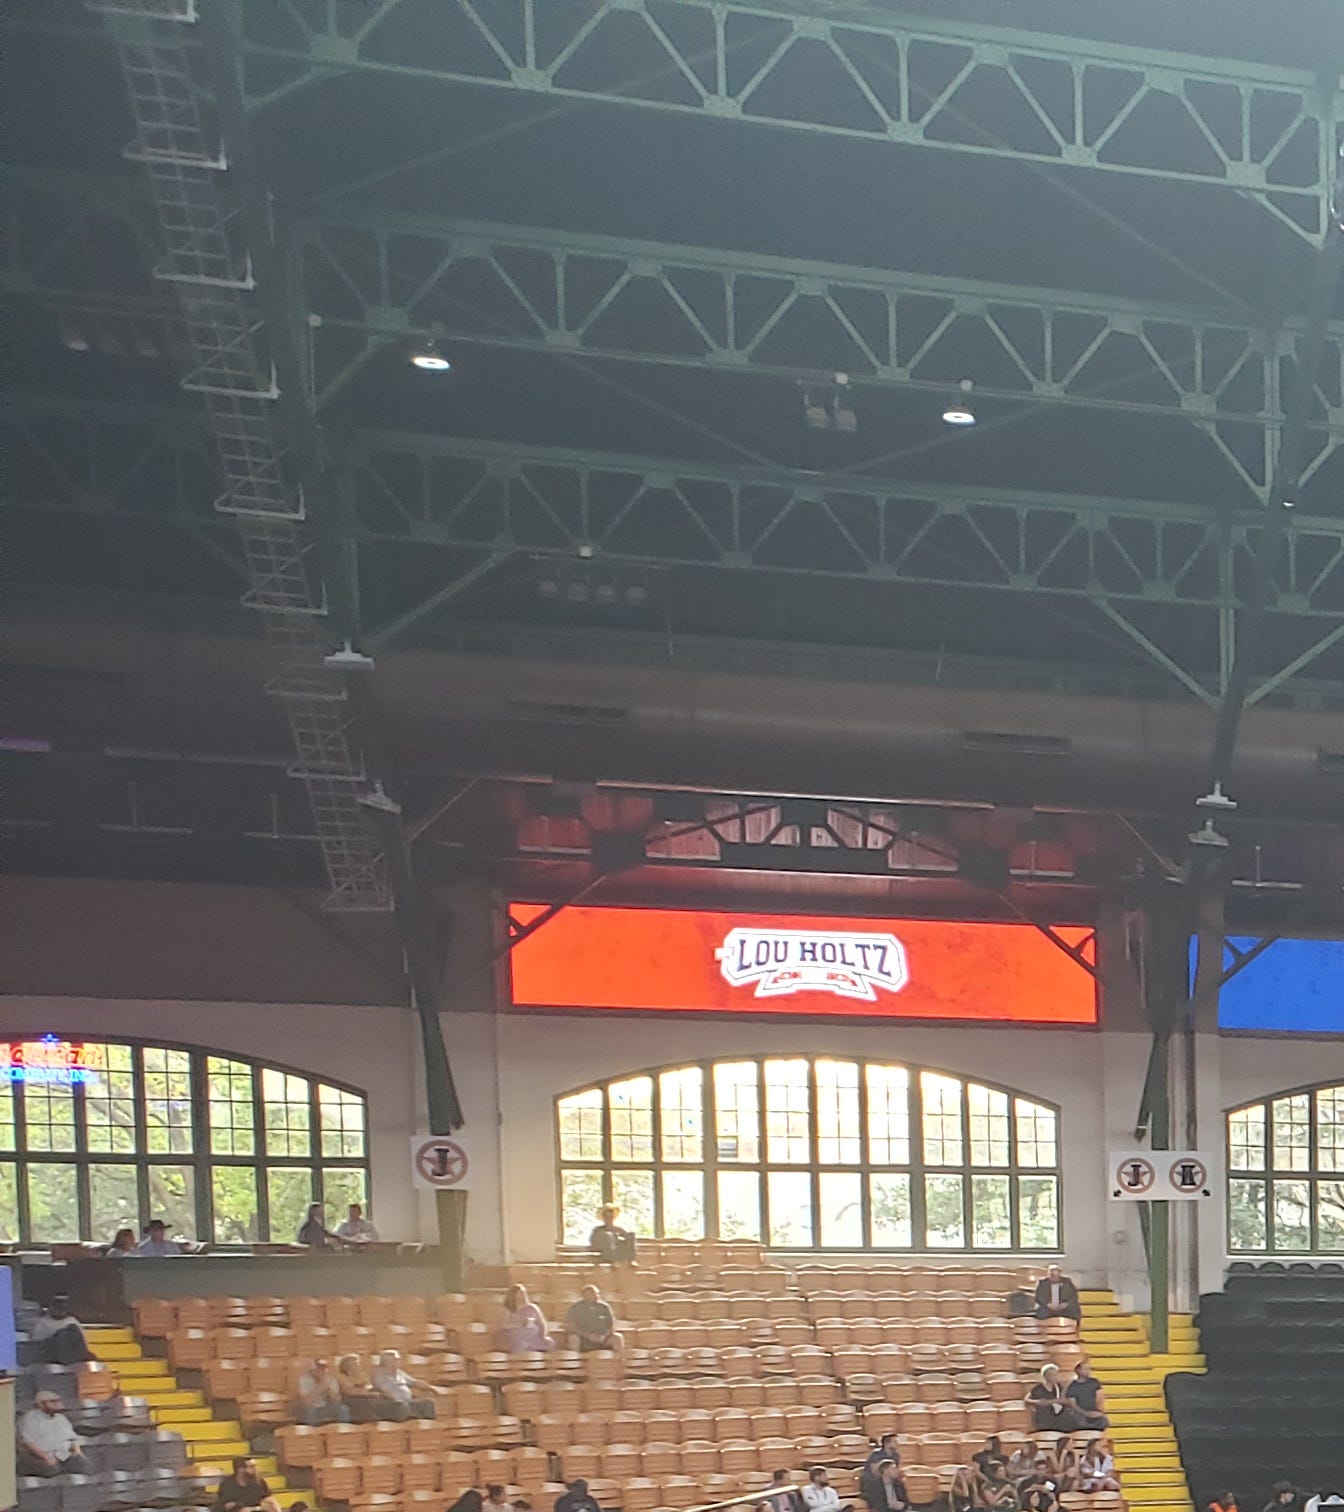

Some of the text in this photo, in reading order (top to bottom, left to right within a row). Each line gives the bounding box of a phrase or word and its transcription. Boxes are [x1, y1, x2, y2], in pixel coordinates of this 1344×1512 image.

[737, 939, 892, 978] LOU HOLTZ
[1128, 1164, 1142, 1187] J
